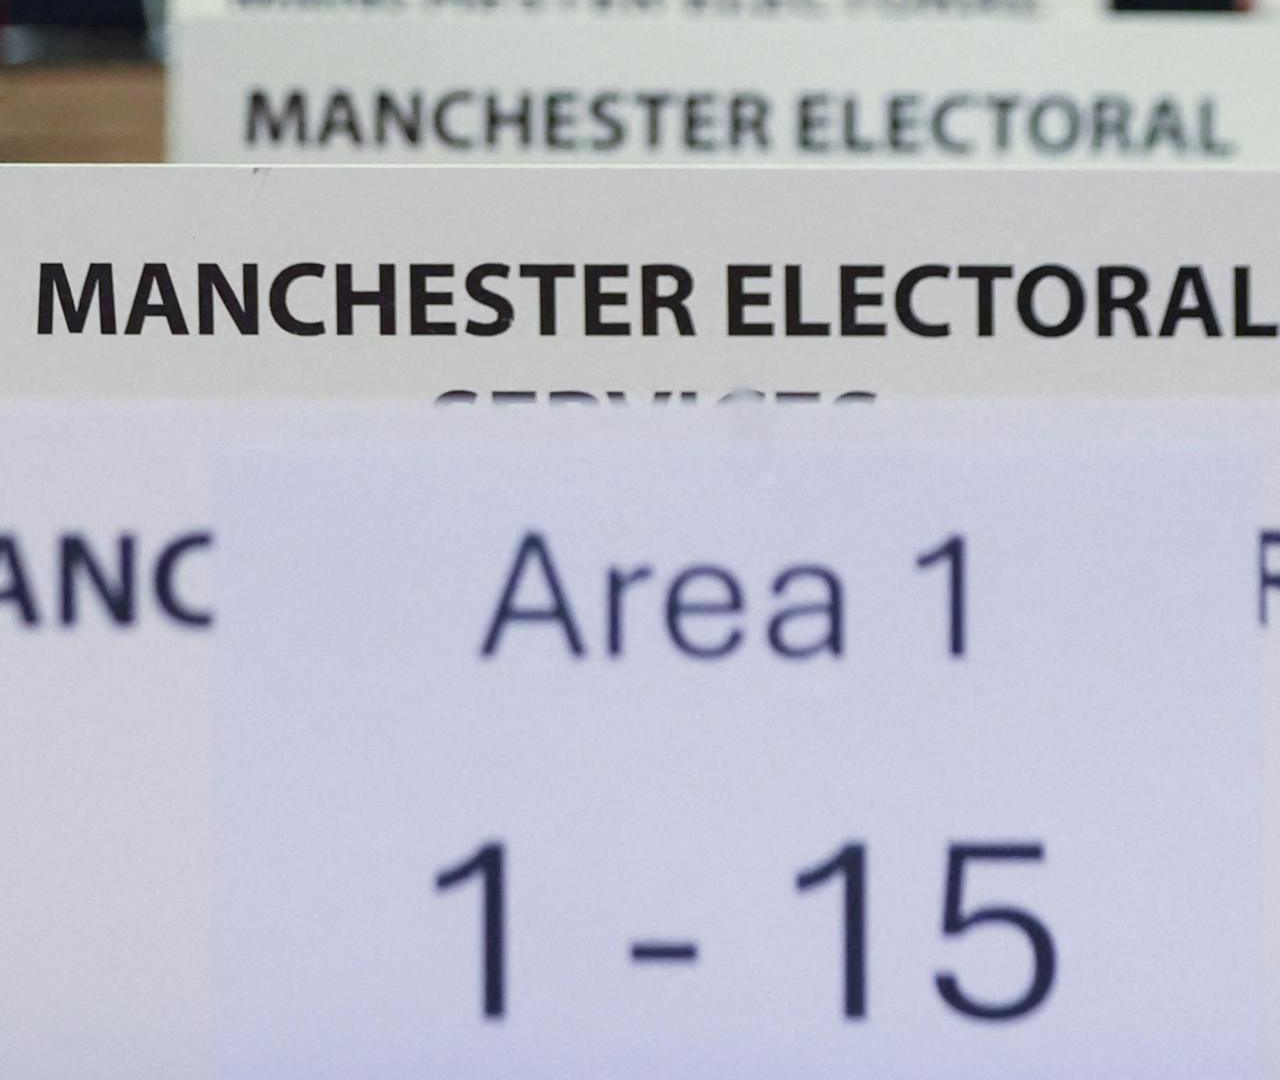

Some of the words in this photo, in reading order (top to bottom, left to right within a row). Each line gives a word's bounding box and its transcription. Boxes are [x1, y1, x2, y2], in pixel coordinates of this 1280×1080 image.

[243, 88, 770, 151] MANCHESTER
[797, 93, 1236, 153] ELECTORAL
[36, 261, 697, 337] MANCHESTER
[725, 262, 1280, 339] ELECTORAL
[479, 530, 846, 661] Area
[915, 533, 967, 660] 1
[434, 840, 508, 1021] 1
[629, 940, 700, 964] -
[793, 840, 1060, 1025] 15
